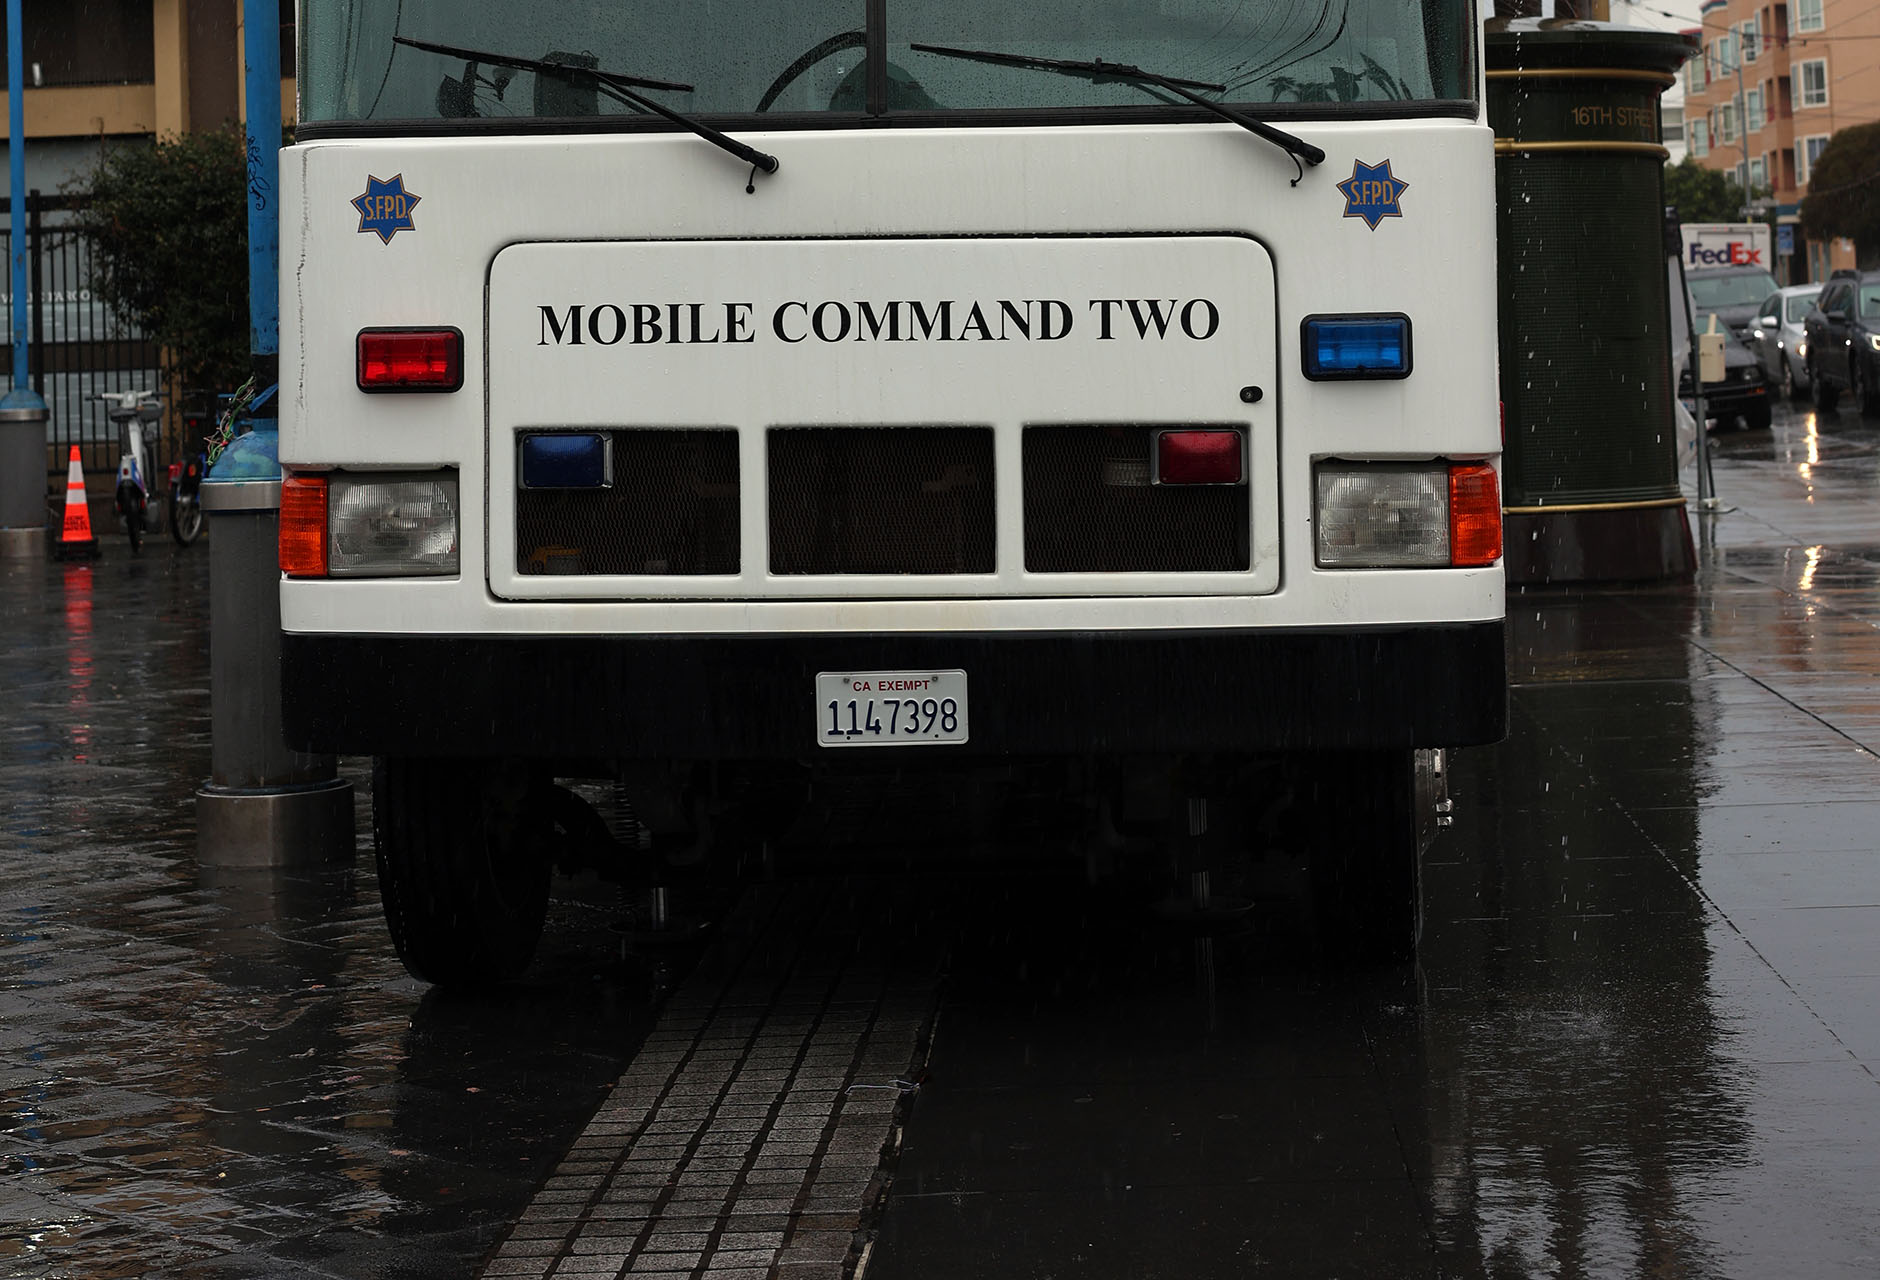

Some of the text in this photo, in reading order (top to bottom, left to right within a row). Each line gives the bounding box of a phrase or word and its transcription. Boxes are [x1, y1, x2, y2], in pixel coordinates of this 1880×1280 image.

[1571, 106, 1612, 126] 16TH
[1350, 180, 1395, 206] S.F.P.D.
[364, 194, 408, 221] S.F.P.D.
[1689, 241, 1761, 265] FedEx
[536, 298, 1220, 346] MOBILE COMMAND TWO
[852, 680, 930, 692] CA EXEMPT
[827, 697, 958, 736] 1147398
